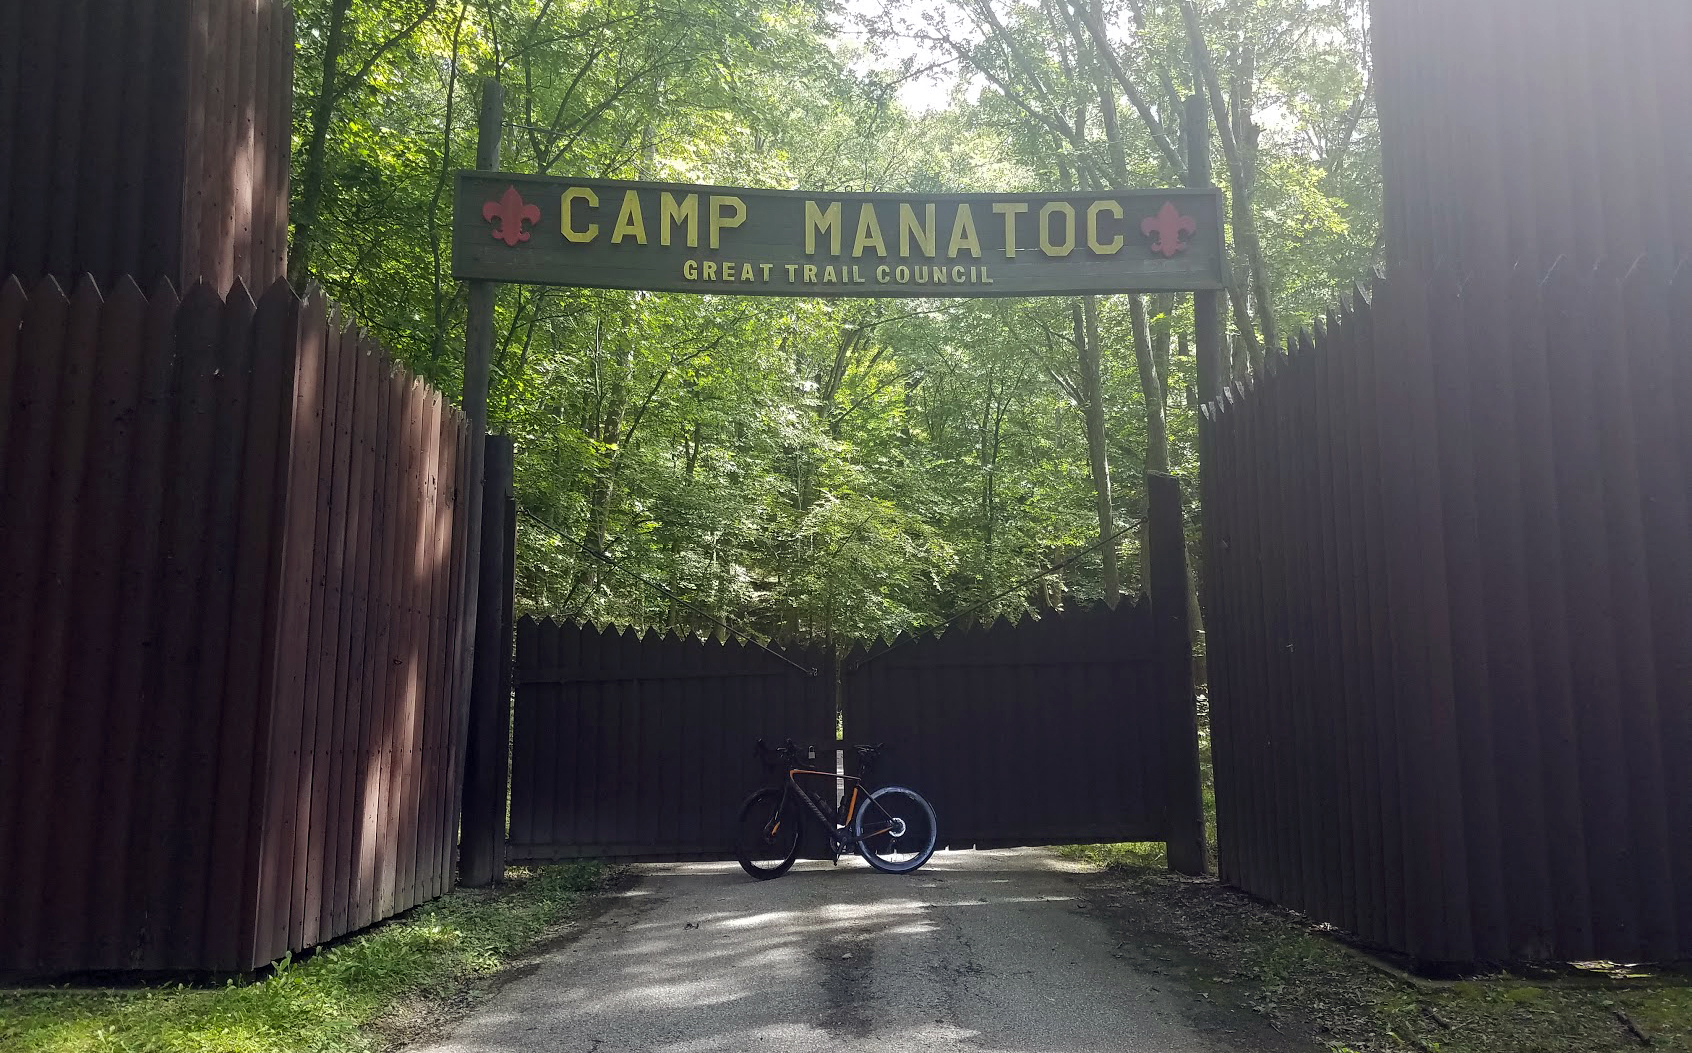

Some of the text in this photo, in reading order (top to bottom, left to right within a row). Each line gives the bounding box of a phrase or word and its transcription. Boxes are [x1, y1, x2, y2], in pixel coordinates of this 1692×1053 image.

[560, 186, 1125, 258] CAMP MANATOC
[683, 259, 994, 284] GREAT TRAIL COUNCIL
